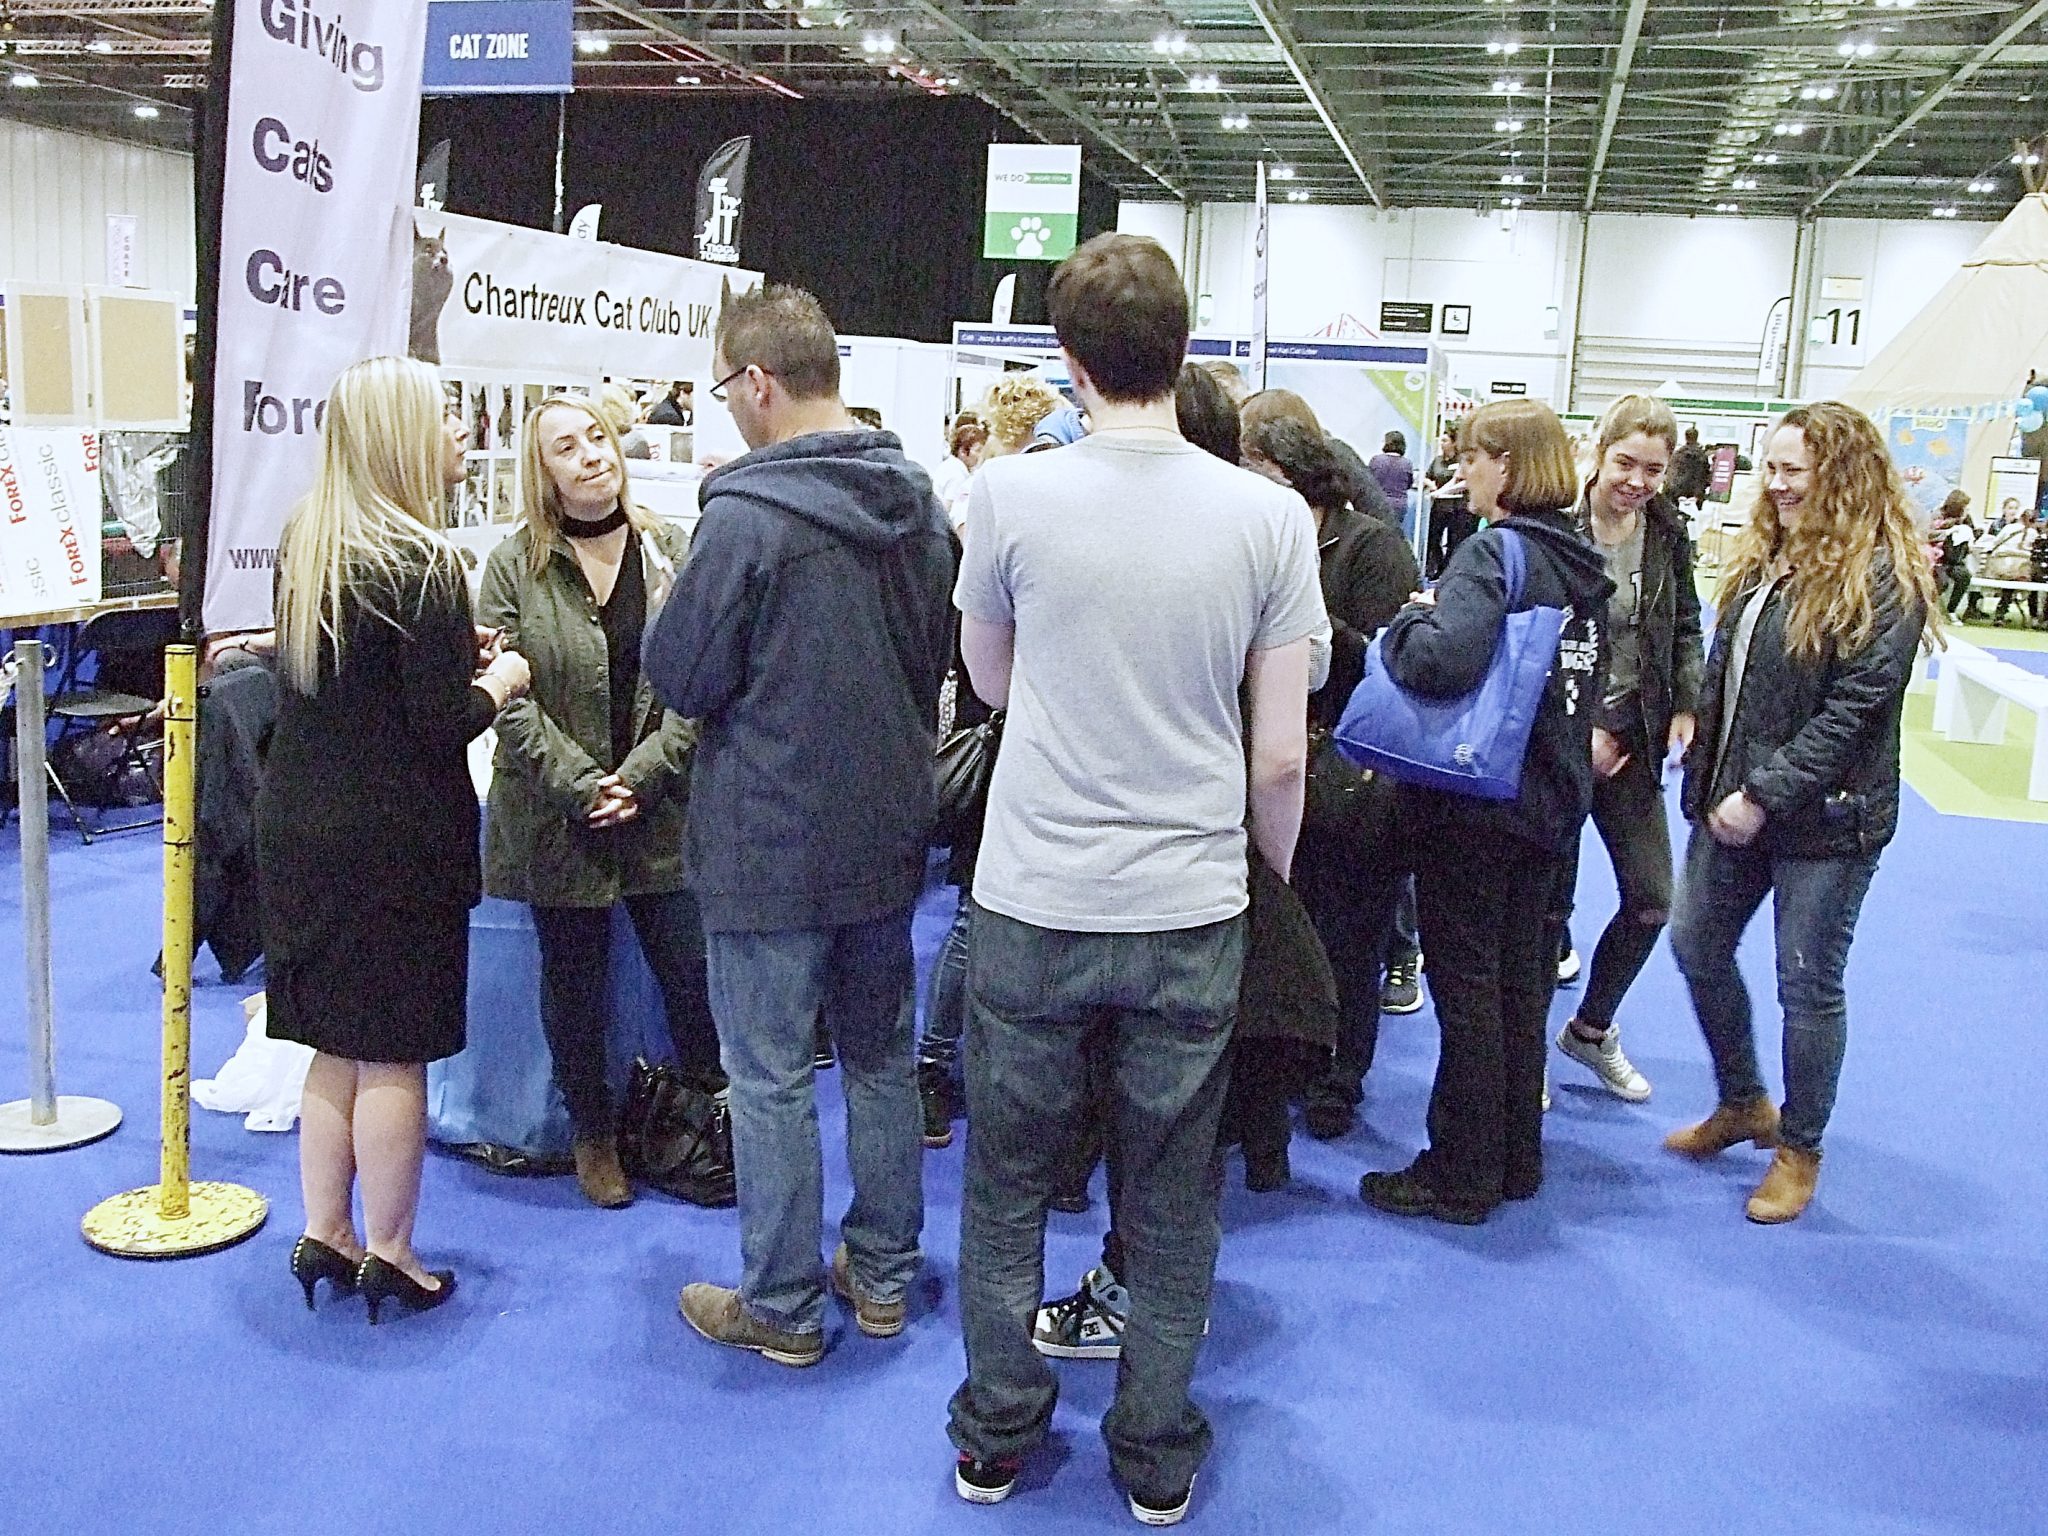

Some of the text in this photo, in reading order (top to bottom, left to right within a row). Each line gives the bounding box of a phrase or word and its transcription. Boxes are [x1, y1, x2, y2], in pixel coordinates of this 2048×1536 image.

[260, 0, 385, 92] Giving
[449, 33, 530, 59] CAT ZONE
[253, 117, 334, 193] Cats
[246, 249, 346, 316] Care
[464, 271, 713, 339] Chartreux Cat Club UK
[1827, 308, 1861, 345] 11
[0, 463, 27, 525] FOREX
[39, 444, 88, 586] FOREX classic
